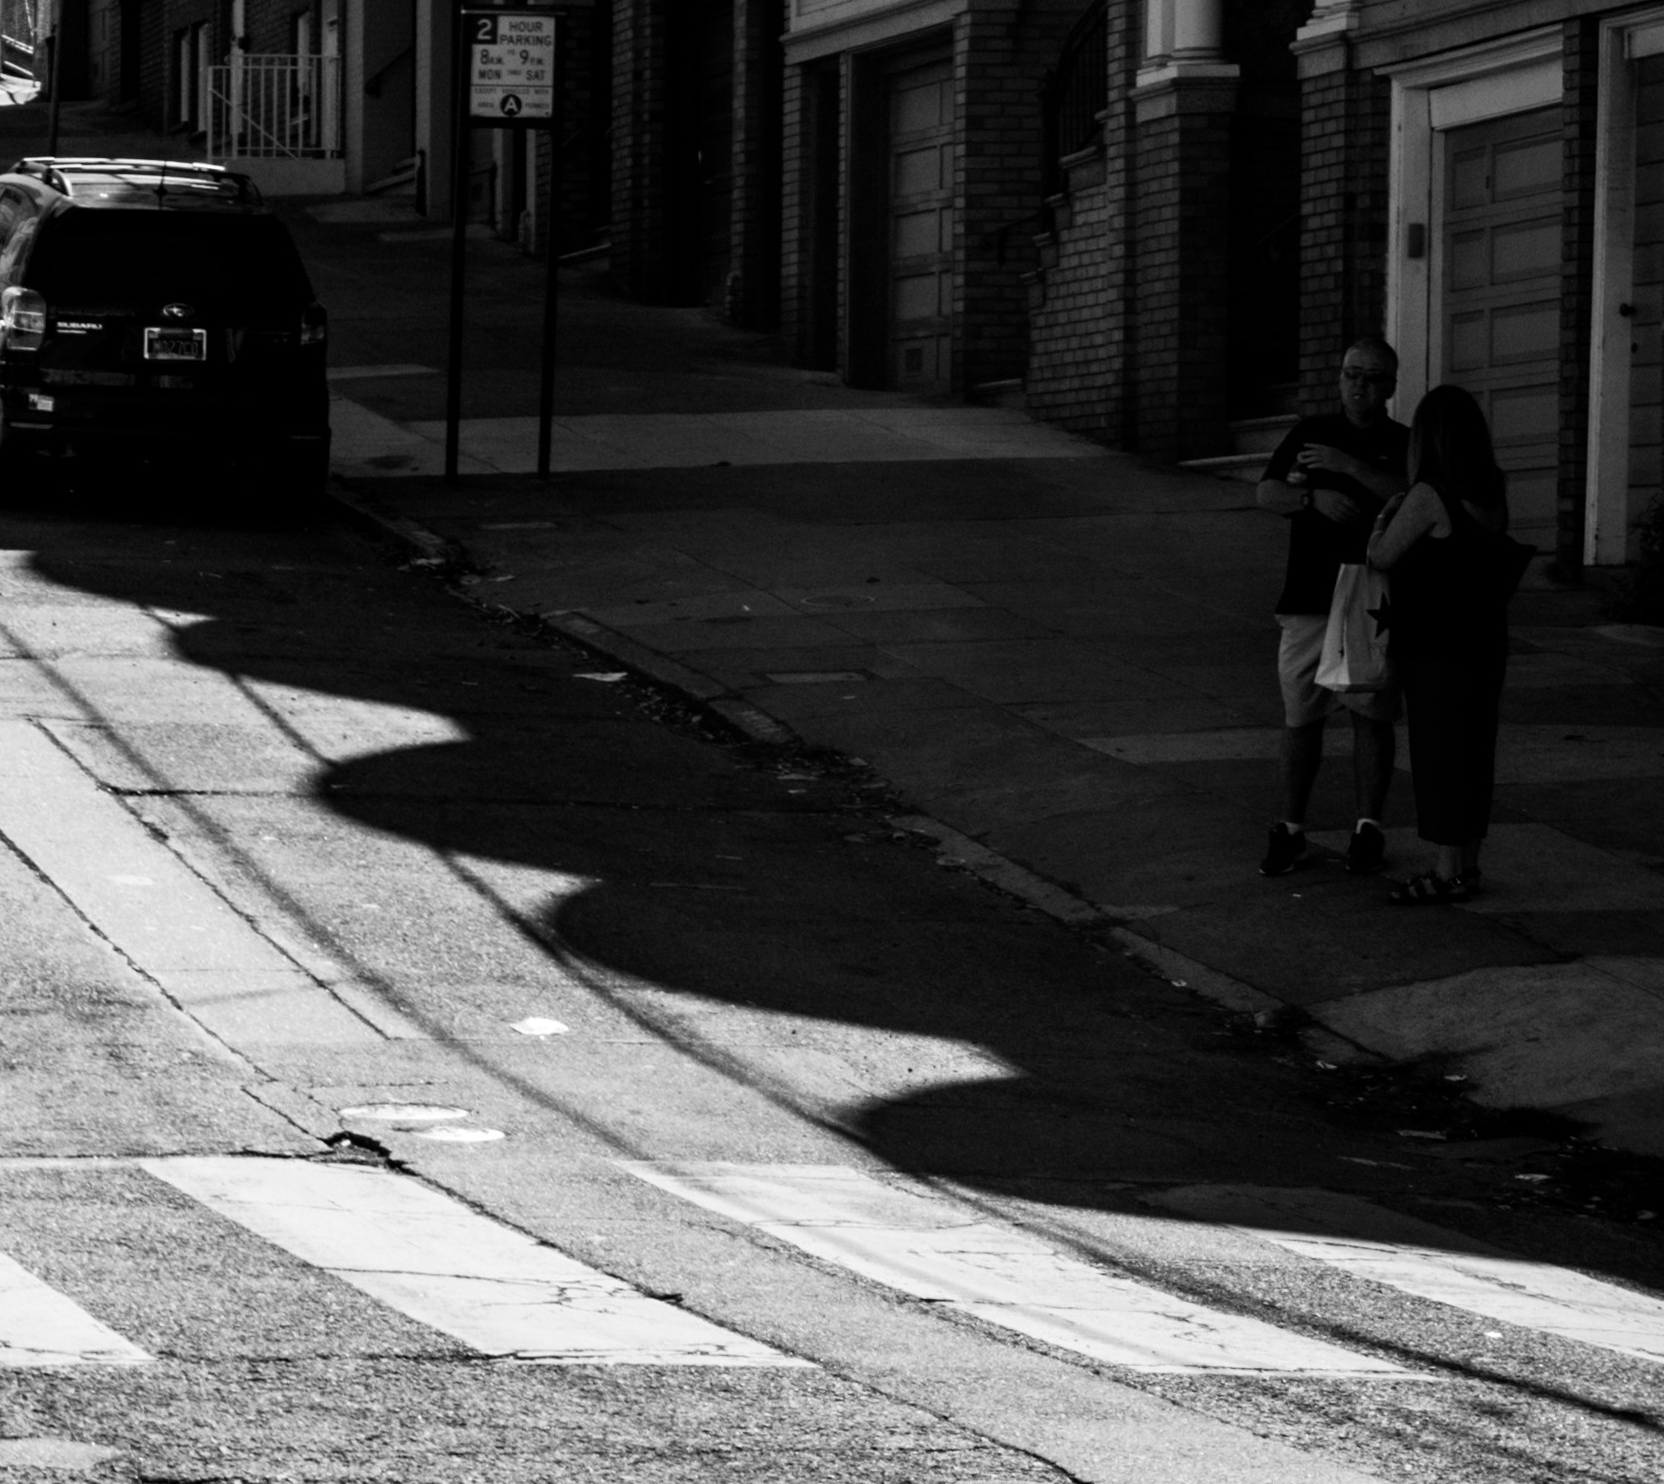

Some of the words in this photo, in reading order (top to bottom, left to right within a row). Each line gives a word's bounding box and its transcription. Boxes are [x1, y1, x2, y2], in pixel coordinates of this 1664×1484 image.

[477, 19, 492, 40] 2
[509, 21, 544, 33] HOUR
[499, 35, 553, 47] PARKING
[478, 70, 501, 80] MON
[526, 69, 546, 81] SAT
[504, 96, 518, 112] A
[57, 321, 103, 330] SUBARU
